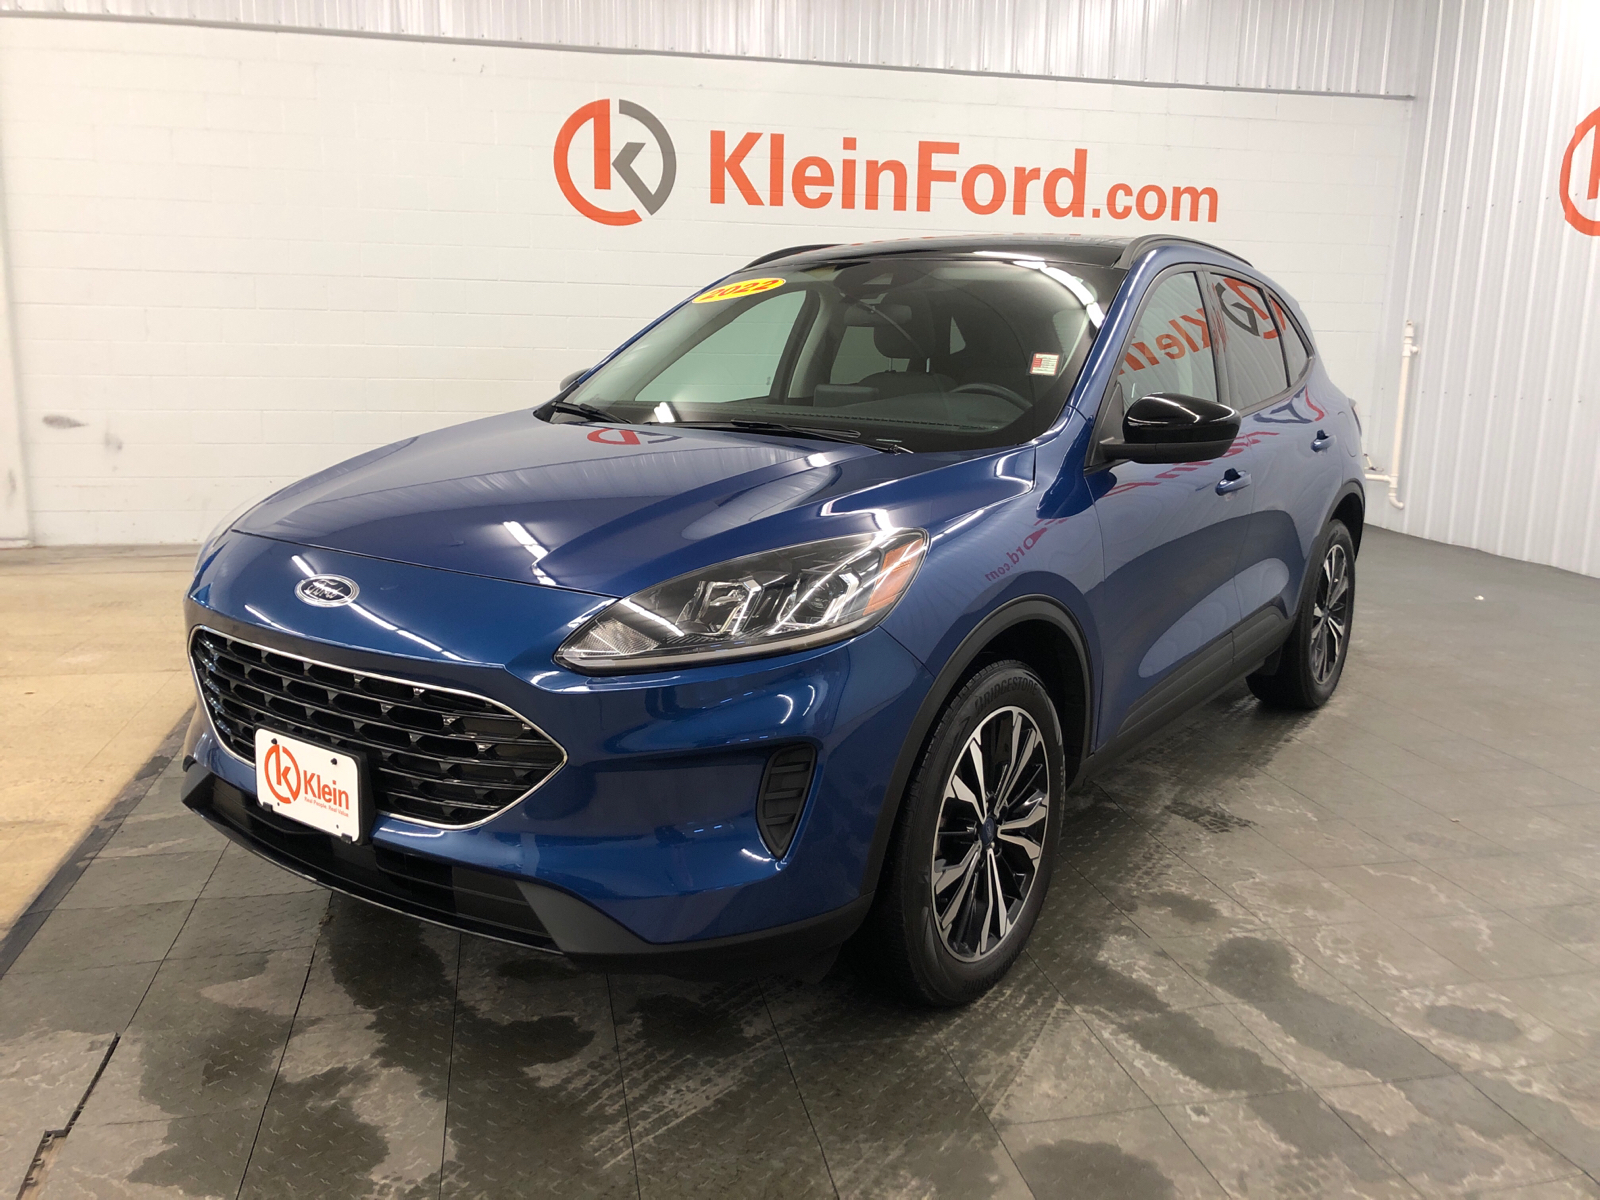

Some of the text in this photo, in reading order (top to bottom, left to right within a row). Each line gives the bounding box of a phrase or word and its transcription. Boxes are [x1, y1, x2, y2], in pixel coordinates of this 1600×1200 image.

[708, 130, 1220, 224] KleinFord.com
[699, 279, 780, 302] 2022
[975, 676, 1039, 714] BRIDGESTONE
[303, 770, 350, 811] Klein
